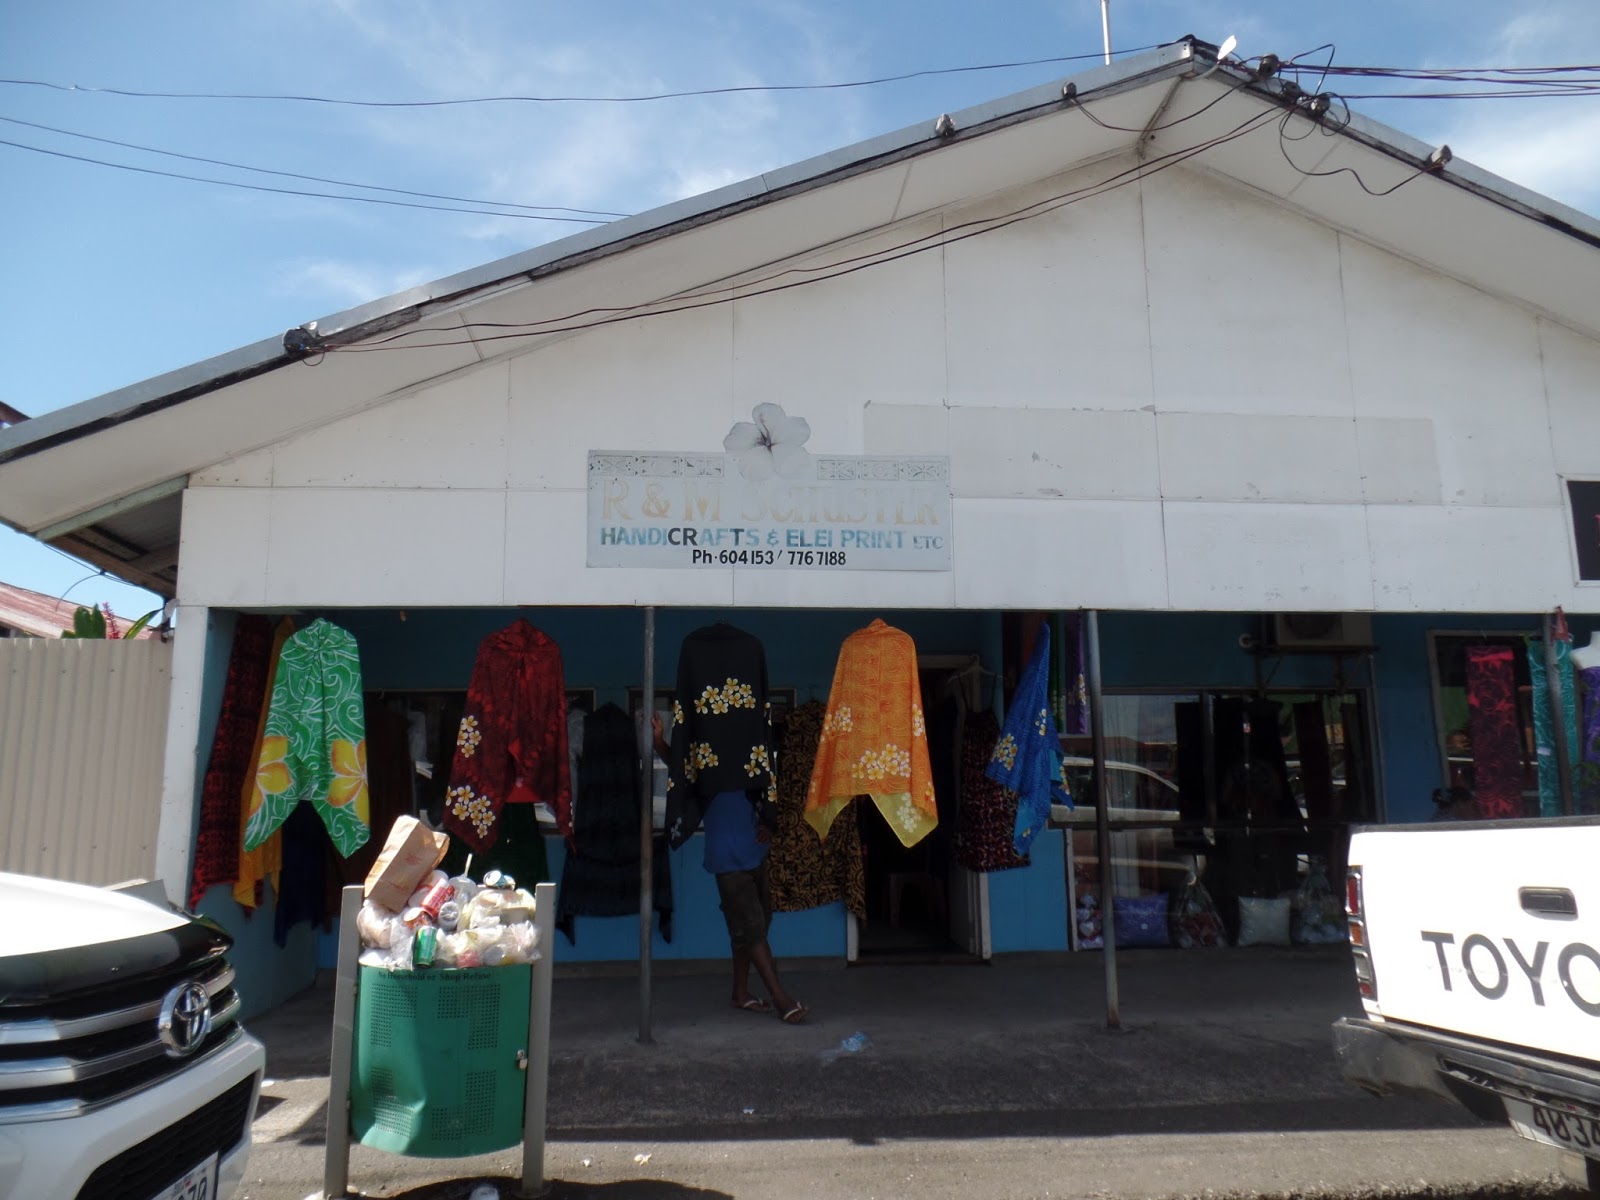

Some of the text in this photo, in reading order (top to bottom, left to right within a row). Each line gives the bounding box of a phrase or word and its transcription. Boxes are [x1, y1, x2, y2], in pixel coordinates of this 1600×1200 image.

[600, 527, 760, 547] HANDICRAFTS
[785, 529, 833, 548] ELEI
[840, 529, 906, 549] PRINT
[912, 535, 944, 550] ETC
[1421, 930, 1600, 1018] TOYO
